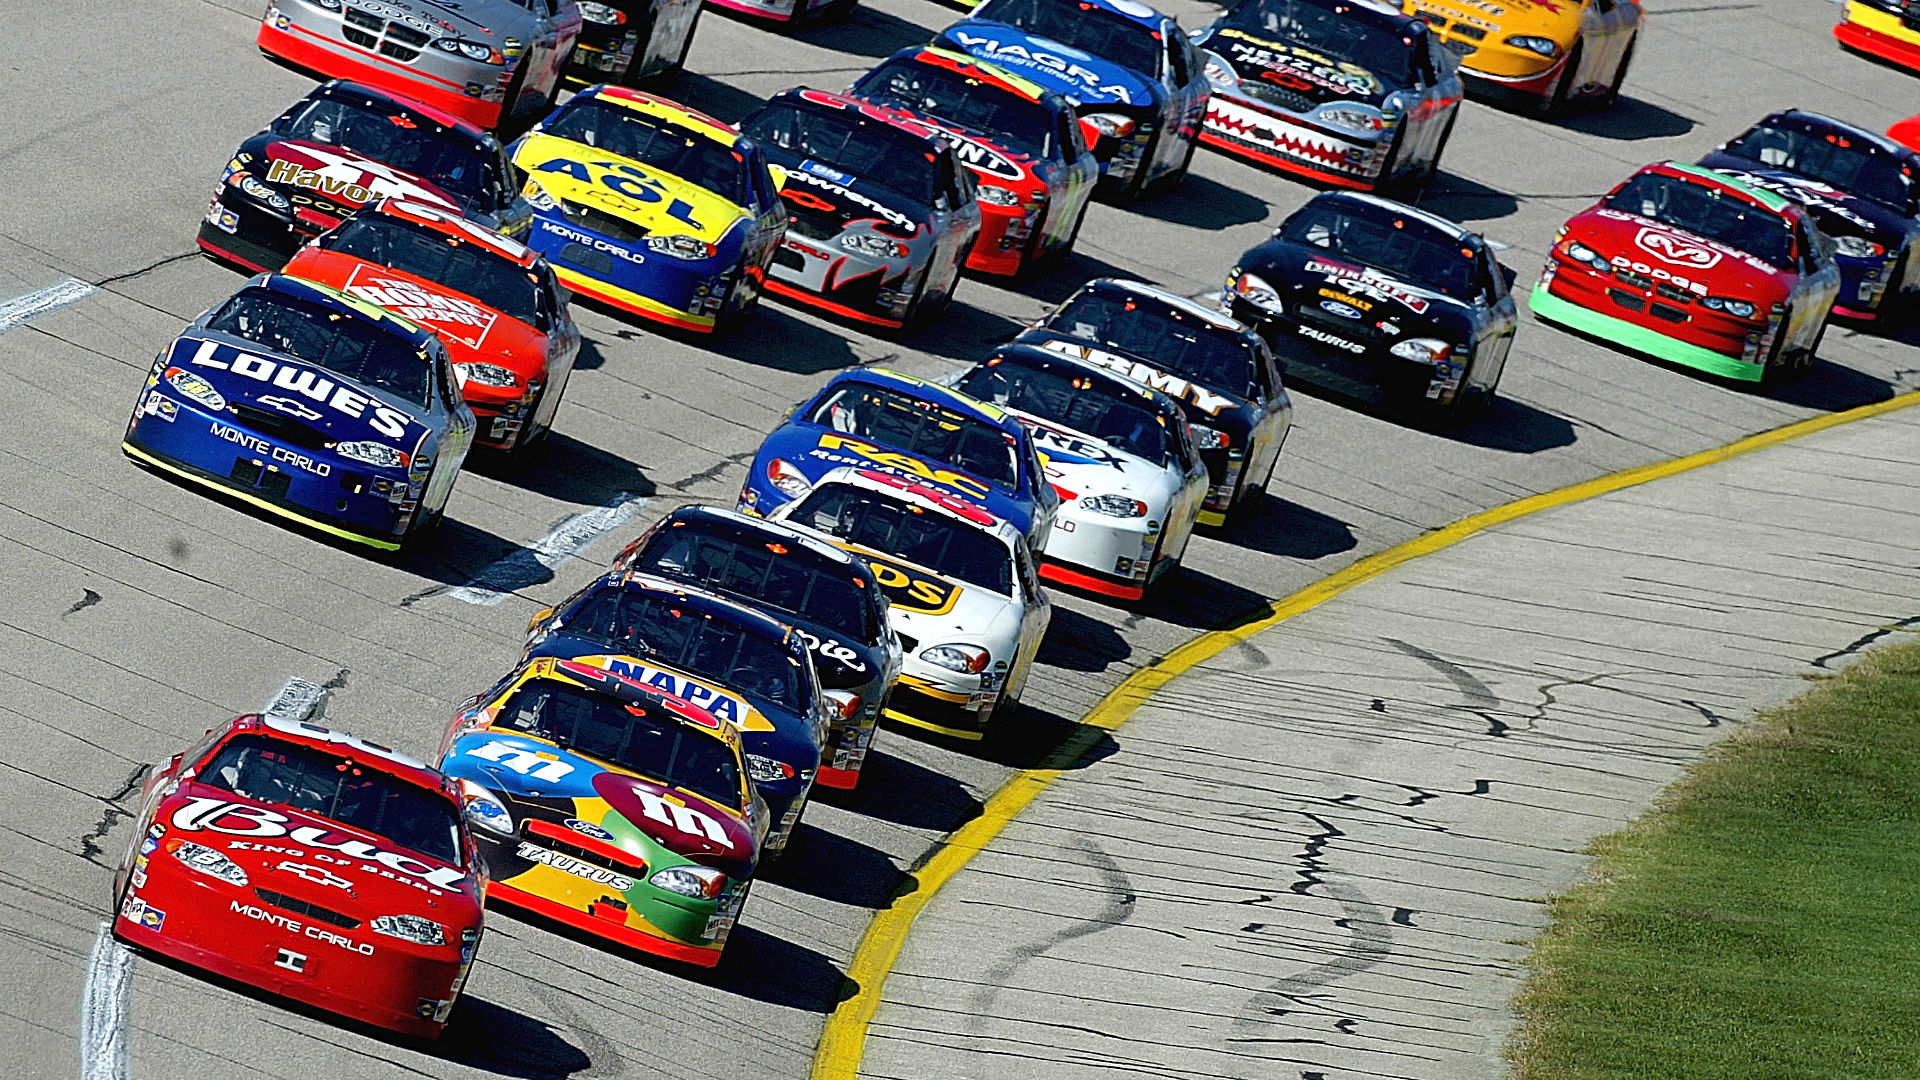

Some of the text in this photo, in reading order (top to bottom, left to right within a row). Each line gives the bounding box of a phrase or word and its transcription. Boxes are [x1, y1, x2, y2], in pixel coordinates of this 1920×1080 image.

[343, 0, 443, 36] ODGE
[957, 31, 1132, 105] VIAGRA
[1231, 43, 1371, 95] NETZERO
[531, 158, 706, 232] AOL
[542, 221, 645, 264] MONTE CARLO
[349, 286, 493, 320] HOME
[1611, 256, 1708, 297] DODGE
[1298, 325, 1367, 354] TAURUS
[192, 340, 414, 441] LOWE'S
[1041, 340, 1241, 416] ARMY
[210, 422, 331, 477] MONTE CARLO
[818, 433, 990, 501] RAC
[610, 660, 738, 724] NAPA
[171, 795, 467, 893] Bud
[227, 840, 305, 857] KING
[314, 854, 351, 866] OF
[516, 841, 635, 891] TAURUS
[229, 899, 375, 956] MONTE CARLO
